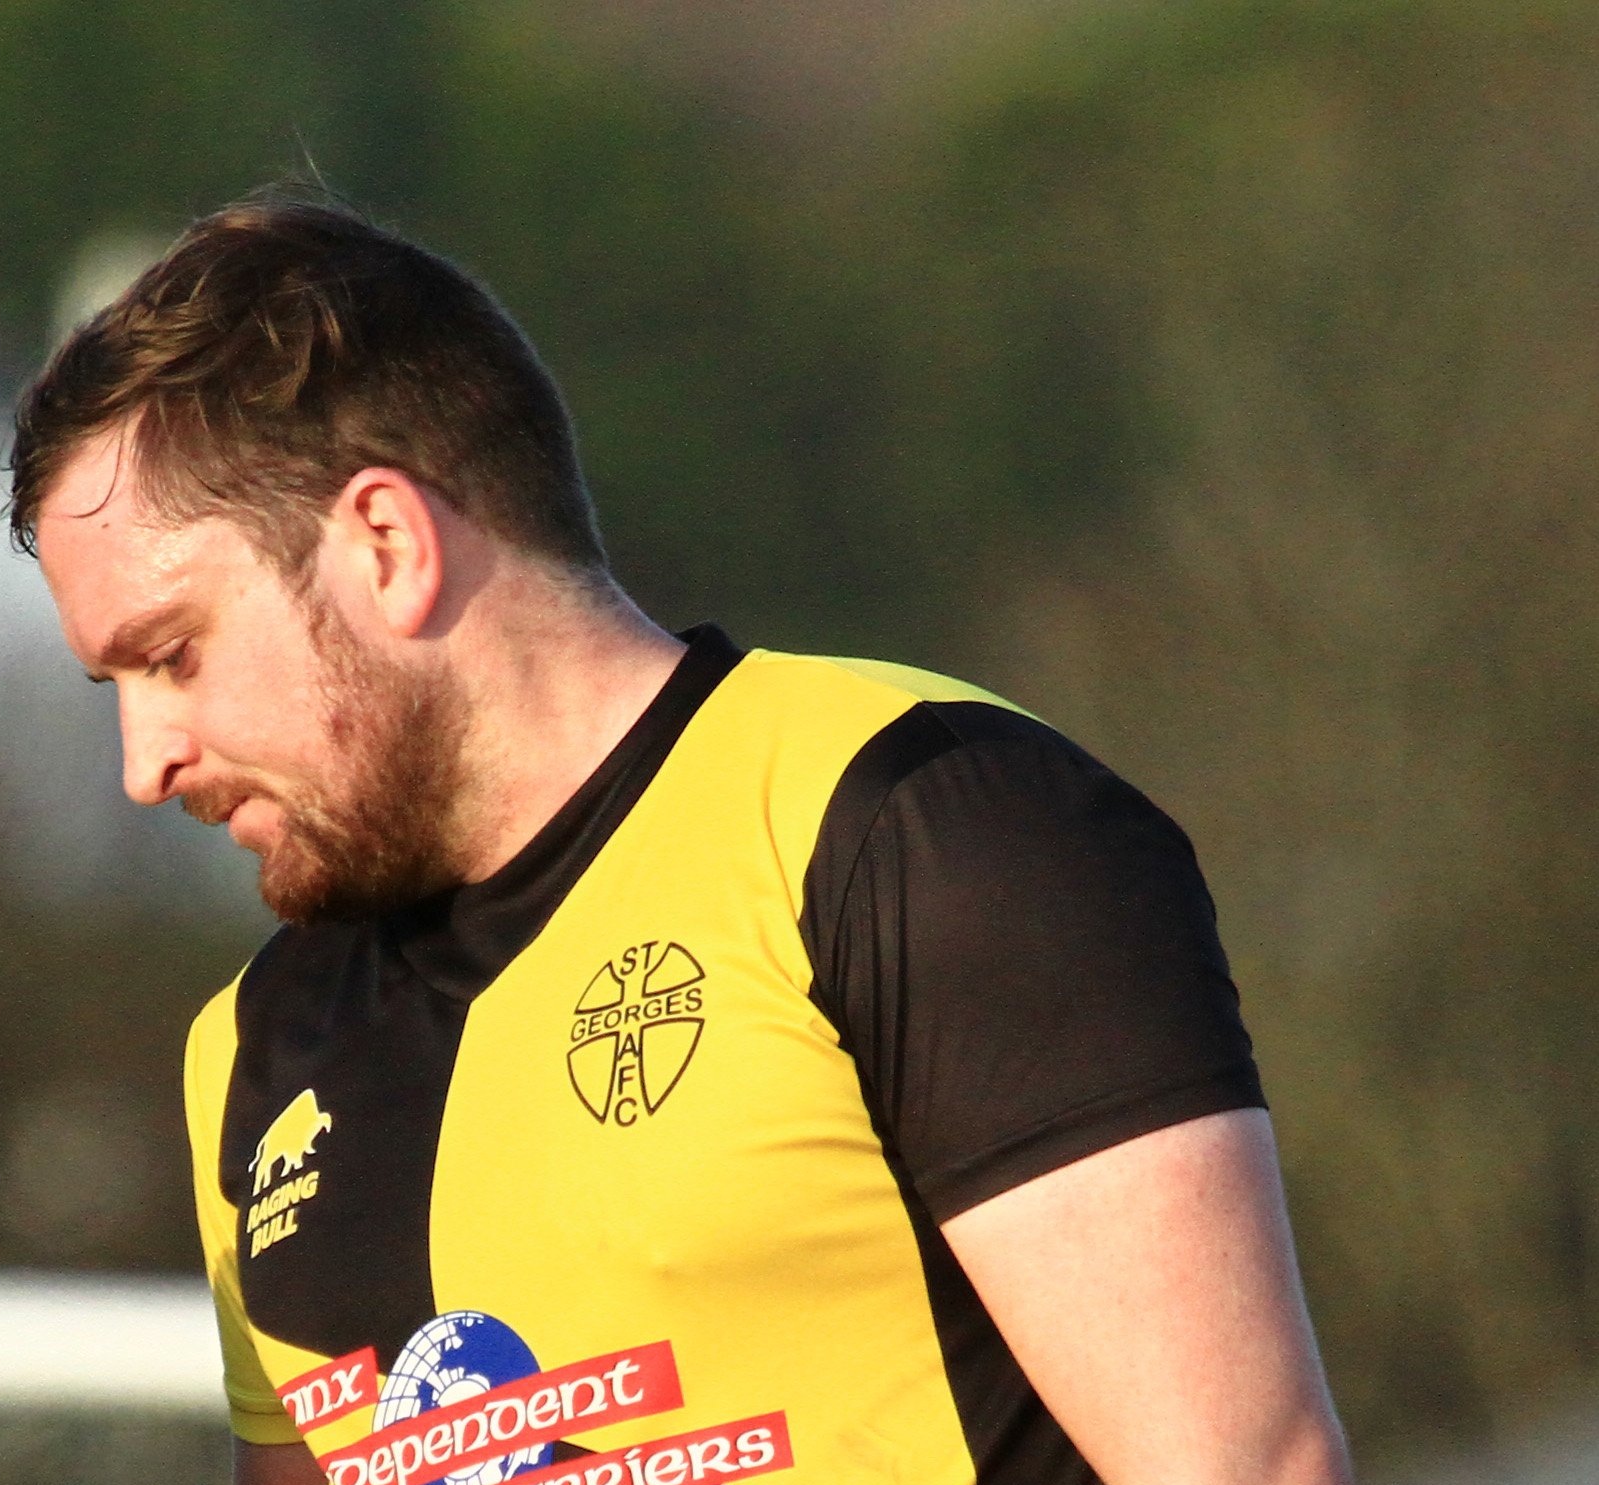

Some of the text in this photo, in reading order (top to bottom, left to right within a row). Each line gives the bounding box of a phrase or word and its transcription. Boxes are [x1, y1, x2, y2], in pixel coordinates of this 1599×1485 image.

[620, 940, 659, 976] ST
[570, 988, 703, 1043] GEORGES
[246, 1171, 320, 1234] RAGING
[250, 1208, 298, 1259] BULL
